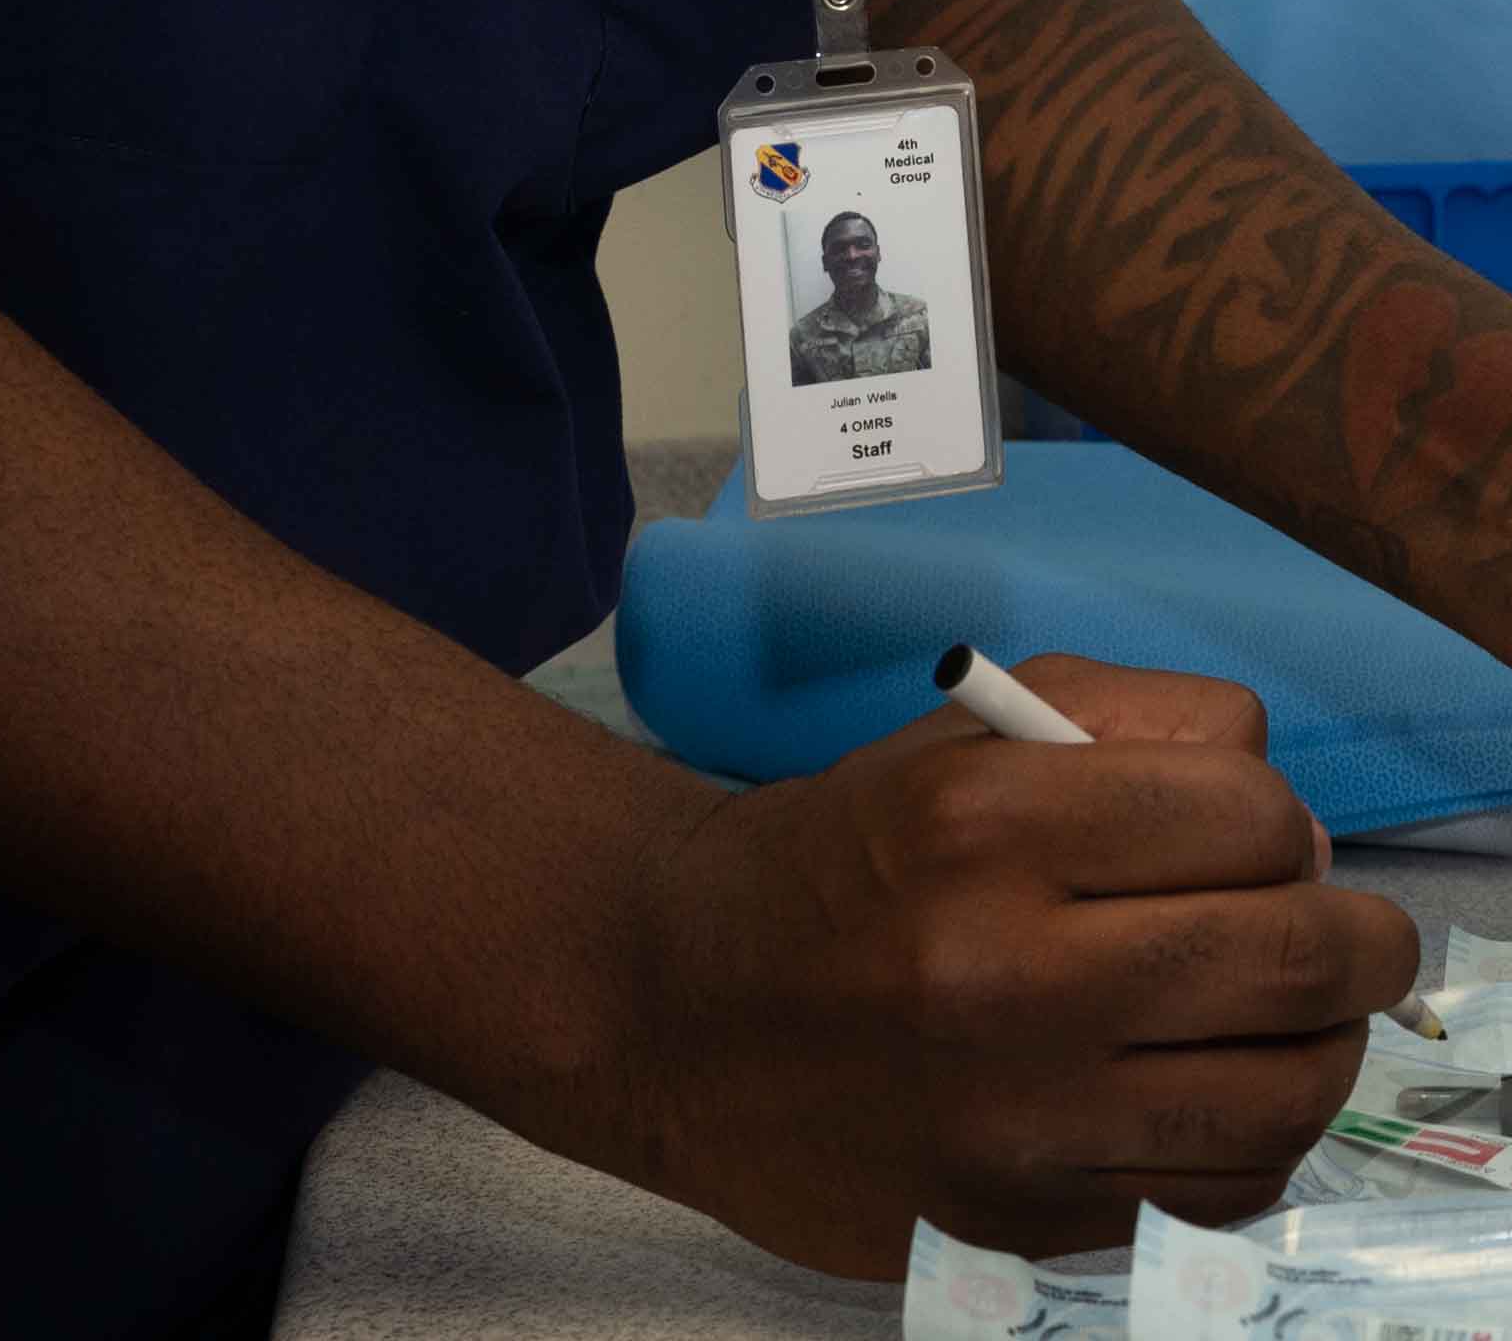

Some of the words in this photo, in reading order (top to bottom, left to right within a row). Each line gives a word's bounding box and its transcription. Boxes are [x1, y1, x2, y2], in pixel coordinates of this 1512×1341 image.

[898, 139, 918, 151] 4th
[884, 153, 935, 169] Medical
[890, 170, 931, 185] Group
[830, 396, 861, 409] Julian
[866, 390, 897, 404] Wells
[840, 423, 848, 433] 4
[852, 417, 893, 432] OMRS
[852, 440, 893, 459] Staff
